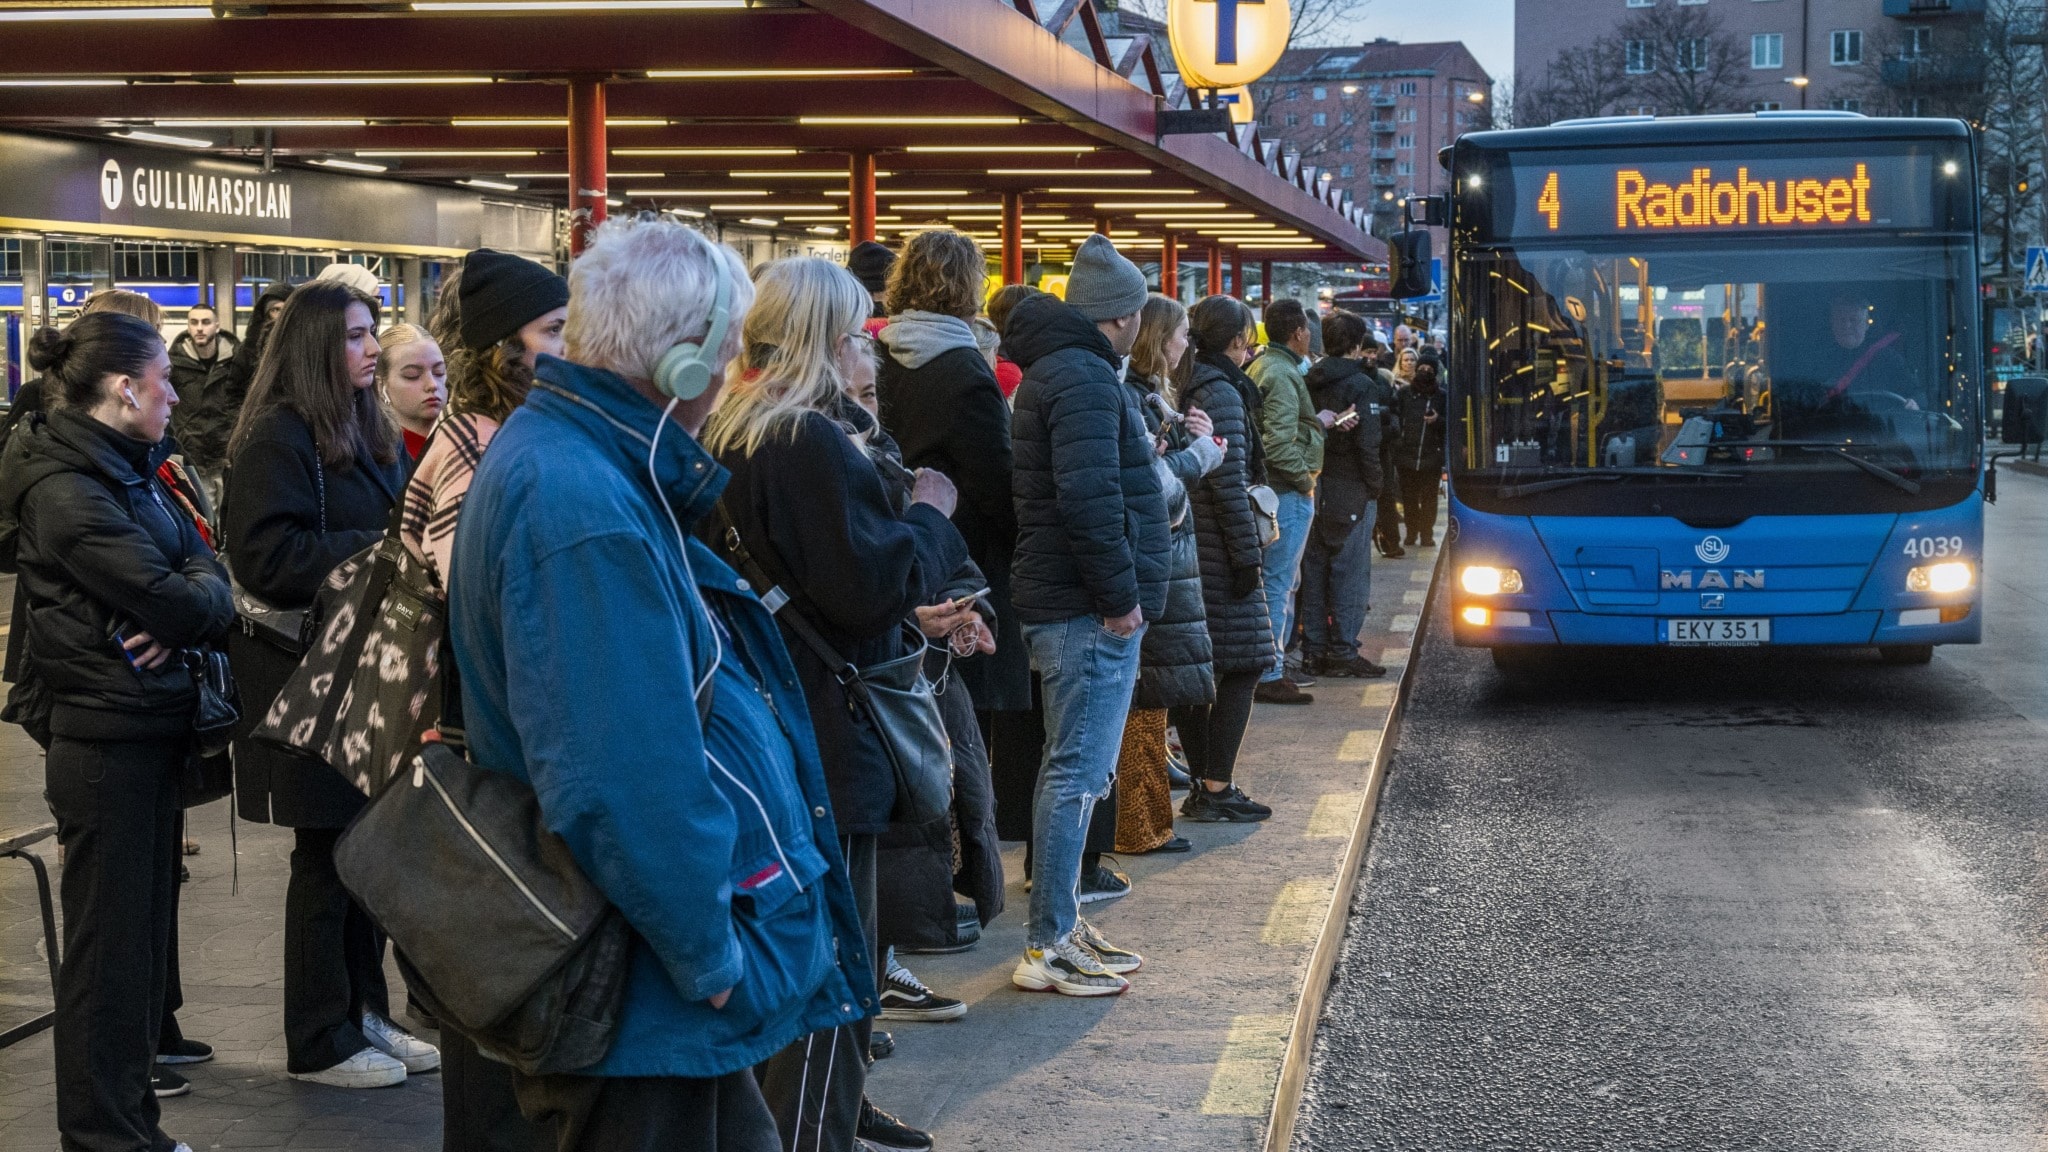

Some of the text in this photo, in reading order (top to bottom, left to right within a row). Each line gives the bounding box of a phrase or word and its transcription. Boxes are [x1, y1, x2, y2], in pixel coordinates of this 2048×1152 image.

[1193, 0, 1265, 65] T
[105, 167, 291, 219] T GULLMARSPLAN
[1538, 163, 1871, 229] 4 Radiohuset
[1499, 449, 1505, 460] 1
[1705, 541, 1721, 552] SL
[1903, 535, 1963, 559] 4039
[1661, 569, 1765, 589] MAN
[1676, 622, 1760, 639] EKY 351
